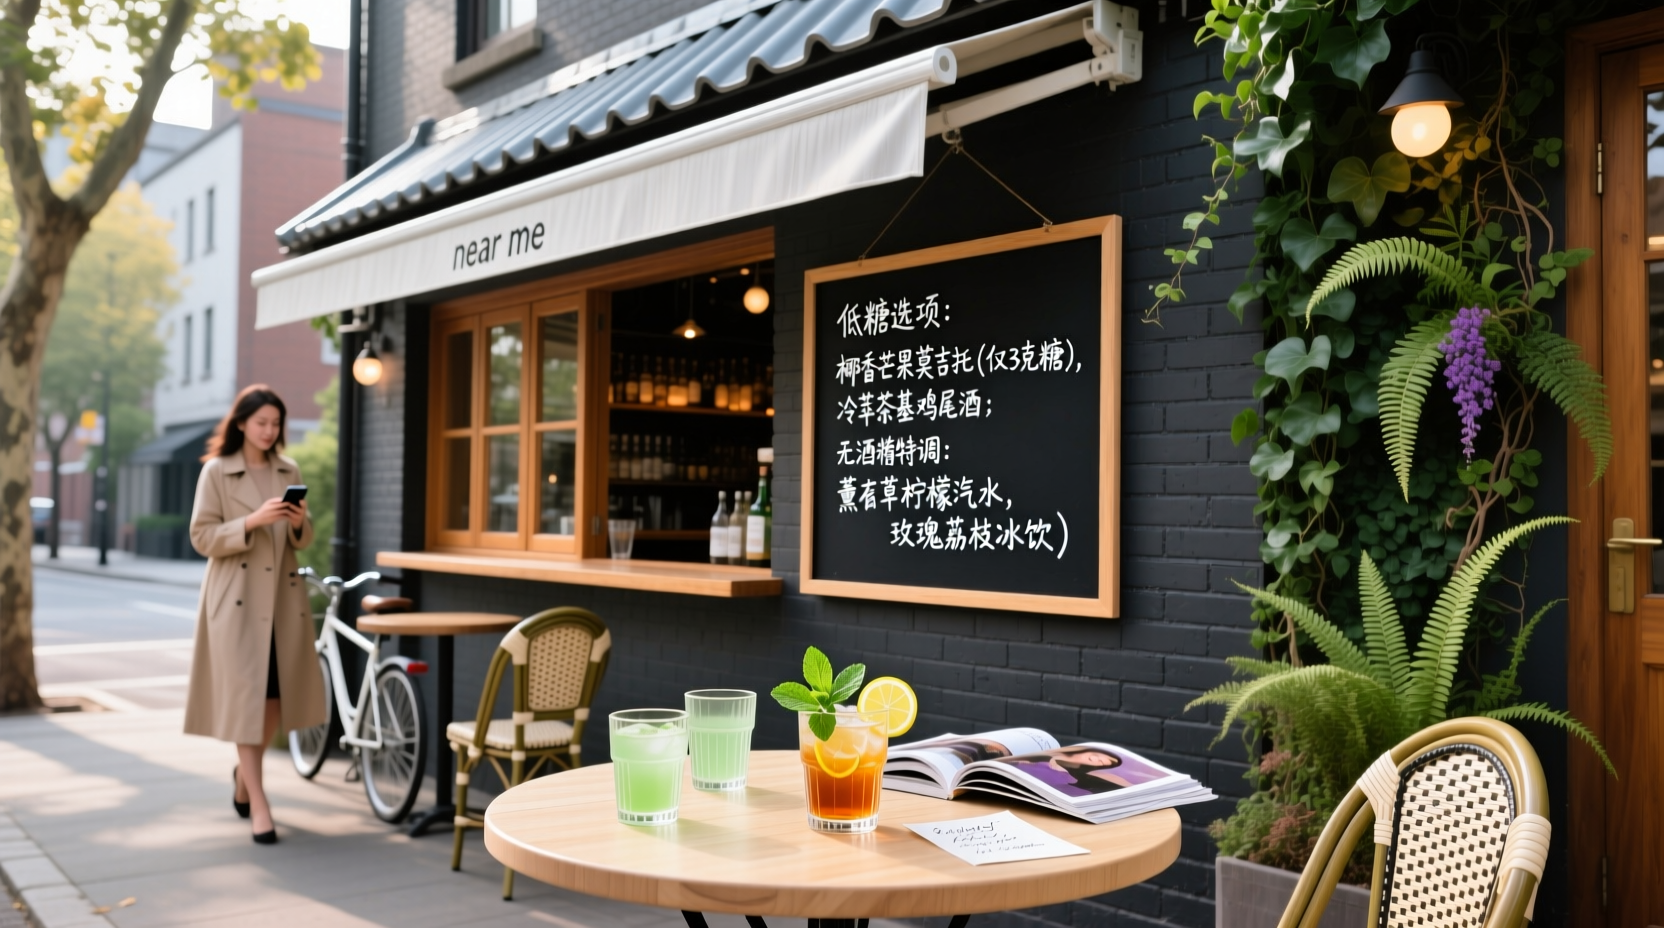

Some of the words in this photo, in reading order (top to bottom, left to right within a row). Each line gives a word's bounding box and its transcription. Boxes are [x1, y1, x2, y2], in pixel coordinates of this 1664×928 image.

[453, 233, 502, 271] near
[507, 222, 545, 257] me
[836, 293, 950, 338] 低糖选项：
[889, 511, 1069, 560] 玫瑰荔枝冰饮）
